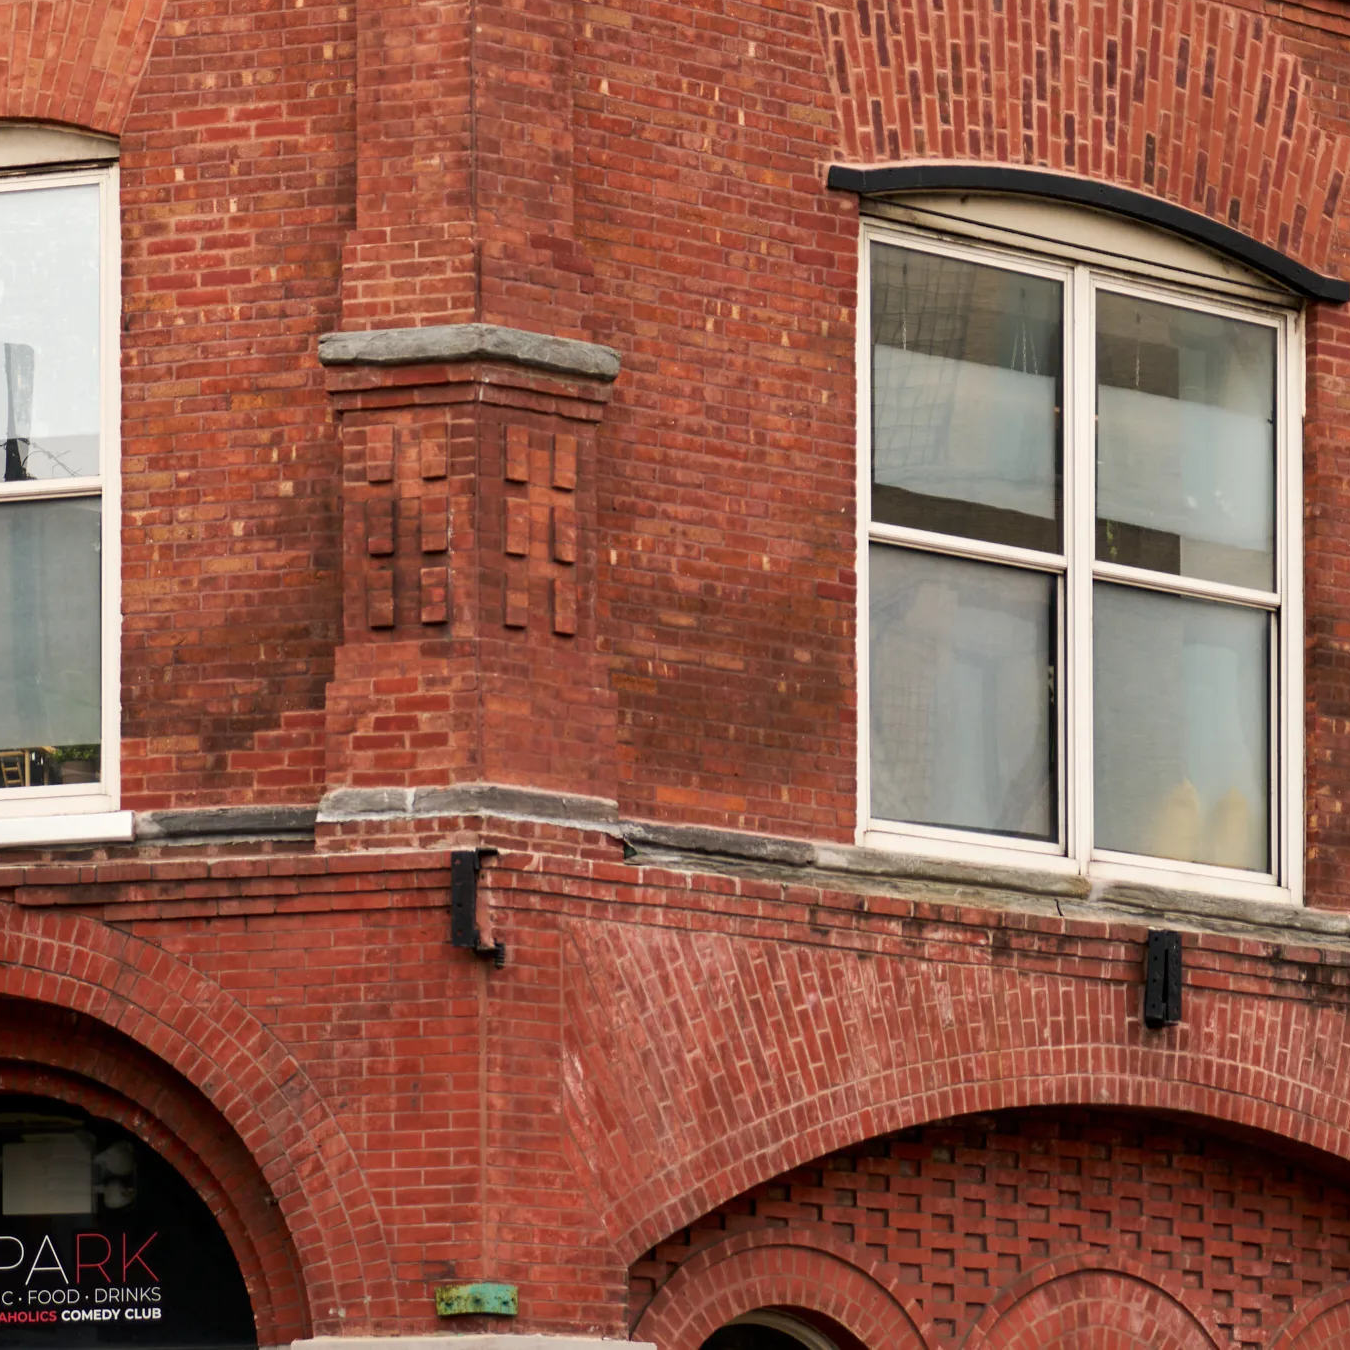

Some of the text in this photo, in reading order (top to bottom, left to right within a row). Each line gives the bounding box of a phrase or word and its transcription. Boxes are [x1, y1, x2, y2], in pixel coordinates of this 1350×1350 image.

[28, 1288, 80, 1305] FOOD
[94, 1286, 162, 1303] DRINKS
[60, 1308, 121, 1323] COMEDY
[124, 1307, 162, 1321] CLUB
